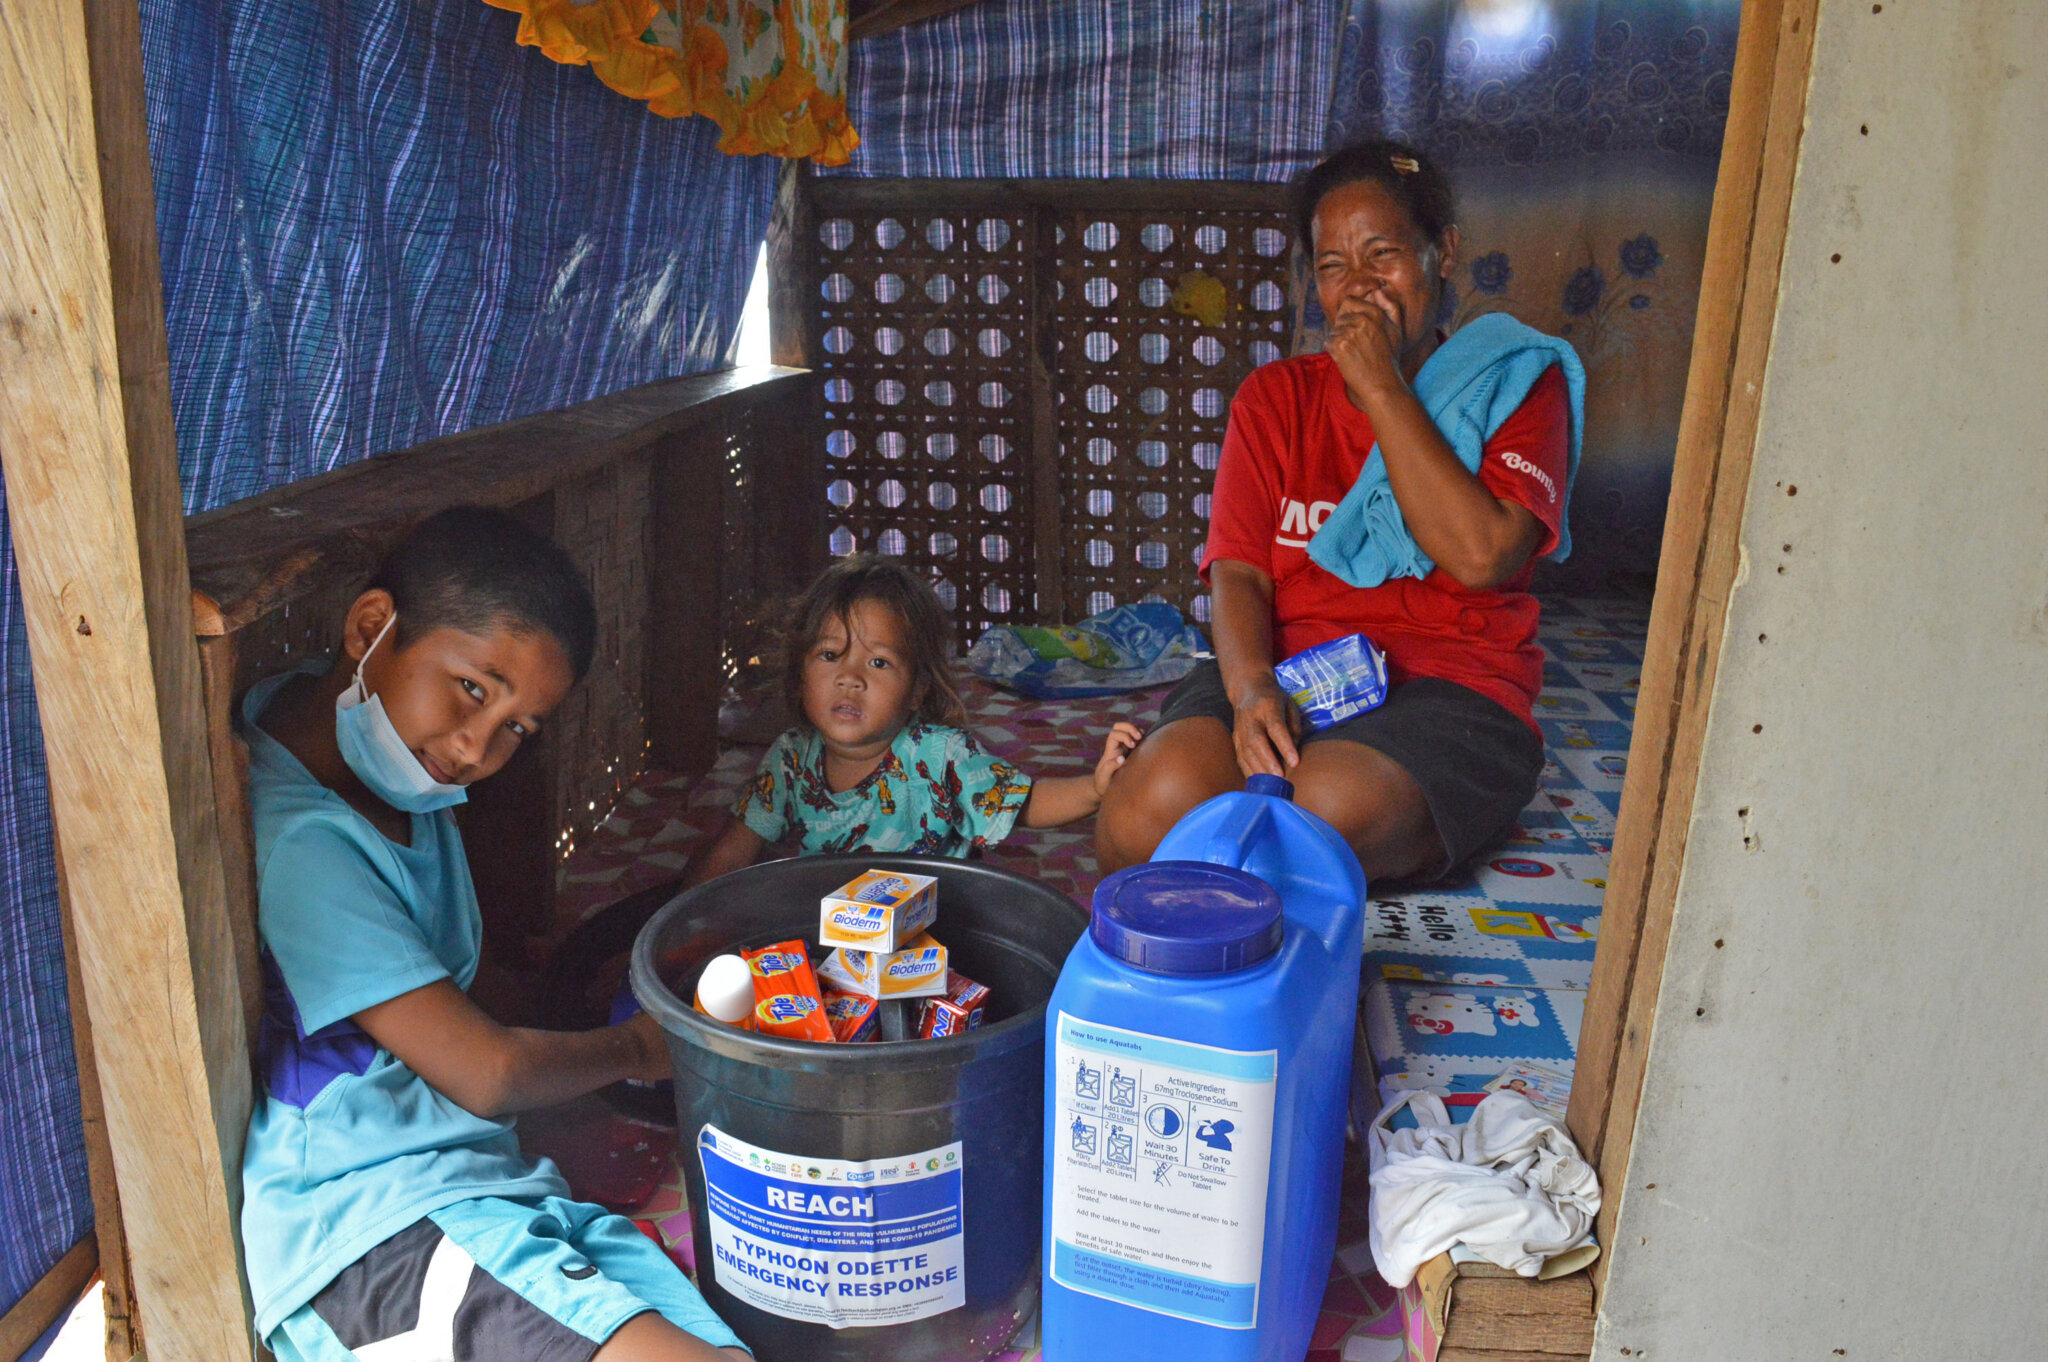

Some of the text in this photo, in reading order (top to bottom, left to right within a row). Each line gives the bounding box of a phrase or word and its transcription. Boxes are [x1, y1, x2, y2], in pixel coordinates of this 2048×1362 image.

[1501, 452, 1557, 503] Bounty
[834, 914, 880, 930] Bioderm
[1373, 900, 1410, 941] Kitty
[1417, 906, 1457, 941] Hello
[760, 954, 791, 975] Tide
[889, 961, 936, 976] Bioderm
[770, 998, 806, 1021] Tide
[1071, 1029, 1085, 1038] How
[1109, 1039, 1142, 1051] Aquatabs
[1212, 1096, 1238, 1108] Sodium
[1144, 1149, 1179, 1162] Minutes
[1145, 1140, 1178, 1153] Wait 30
[1198, 1153, 1231, 1166] Safe To
[1202, 1162, 1226, 1173] Drink
[1188, 1173, 1199, 1181] Not
[1200, 1175, 1227, 1186] Swallow
[1191, 1181, 1212, 1191] Tablet
[766, 1186, 874, 1218] REACH
[1077, 1185, 1096, 1195] Select
[1109, 1193, 1128, 1202] tablet
[1130, 1198, 1141, 1206] size
[1154, 1204, 1165, 1212] the
[1166, 1207, 1191, 1217] volume
[1200, 1214, 1219, 1223] water
[737, 1208, 747, 1217] THE
[747, 1213, 766, 1224] UNMET
[766, 1220, 810, 1234] HUMANITARIAN
[811, 1228, 832, 1236] NEEDS
[875, 1226, 916, 1237] VULNERABLE
[917, 1215, 957, 1230] POPULATIONS
[741, 1218, 770, 1233] AFFECTED
[781, 1232, 816, 1243] CONFLICT,
[817, 1237, 858, 1246] DISASTERS,
[892, 1232, 922, 1243] COVID-19
[924, 1222, 957, 1237] PANDEMIC
[1076, 1208, 1089, 1216] Add
[1090, 1211, 1100, 1219] the
[1102, 1215, 1120, 1224] tablet
[1130, 1222, 1141, 1230] the
[1142, 1226, 1161, 1234] water
[732, 1234, 928, 1276] TYPHOON ODETTE
[1075, 1238, 1100, 1250] benefits
[1109, 1248, 1122, 1256] safe
[1076, 1231, 1089, 1239] Wait
[1098, 1237, 1113, 1246] least
[1124, 1244, 1150, 1255] minutes
[1151, 1252, 1164, 1260] and
[1165, 1254, 1180, 1262] then
[1181, 1258, 1199, 1268] enjoy
[1201, 1261, 1212, 1270] the
[716, 1243, 830, 1297] EMERGENCY
[838, 1266, 958, 1297] RESPONSE
